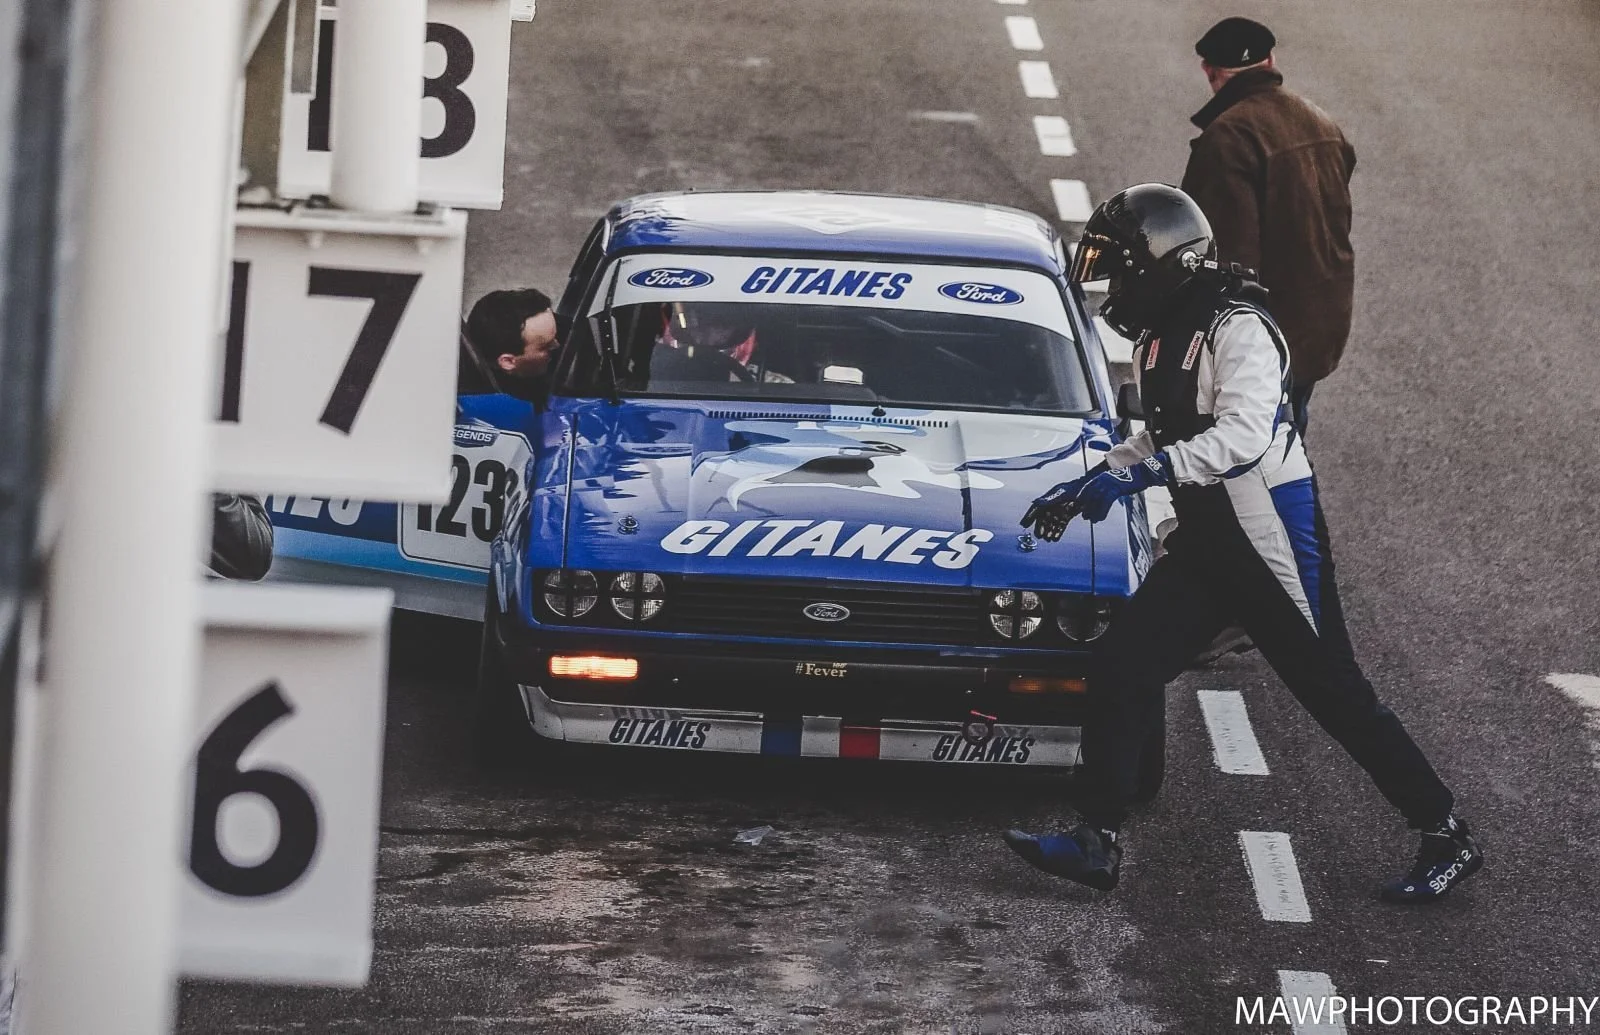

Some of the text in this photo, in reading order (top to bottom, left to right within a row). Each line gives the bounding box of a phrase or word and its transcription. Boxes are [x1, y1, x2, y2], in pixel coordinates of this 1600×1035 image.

[741, 266, 913, 300] GITANES
[219, 260, 423, 437] 17
[416, 454, 506, 542] 23
[660, 520, 994, 569] GITANES
[795, 662, 847, 677] #Fever
[609, 717, 711, 749] GITANES
[932, 734, 1035, 763] GITANES
[189, 679, 320, 899] 6
